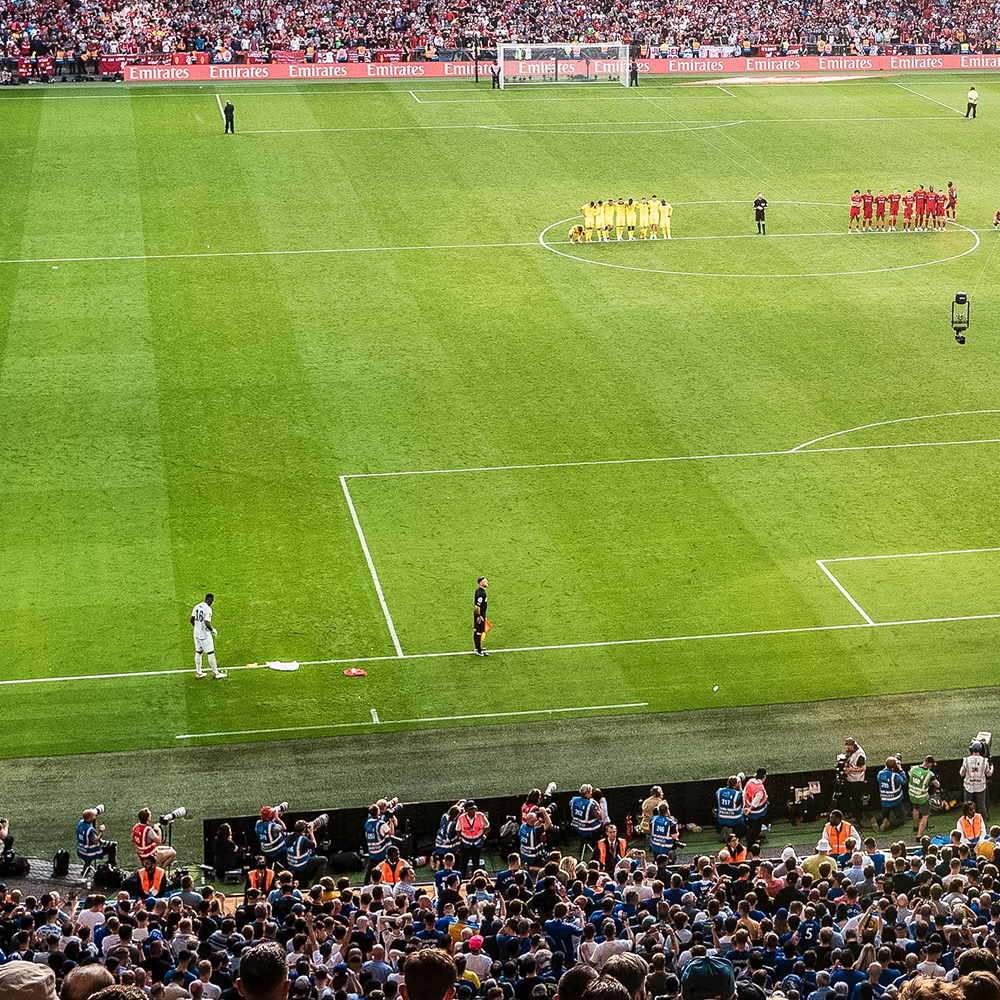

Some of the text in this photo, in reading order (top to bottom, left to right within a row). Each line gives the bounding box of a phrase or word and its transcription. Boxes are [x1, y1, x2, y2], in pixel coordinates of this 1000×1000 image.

[444, 62, 490, 75] Emirat
[519, 61, 575, 74] Emirates
[594, 60, 649, 73] Emires
[669, 59, 724, 72] Emirates
[746, 58, 800, 71] Emirates
[819, 57, 872, 70] Emirates
[890, 56, 943, 68] Emirates
[130, 66, 189, 80] Emirates
[210, 65, 269, 79] Emirates
[289, 64, 348, 77] Emirates
[367, 62, 424, 76] Emirates
[195, 609, 204, 622] 16
[805, 927, 812, 940] 5
